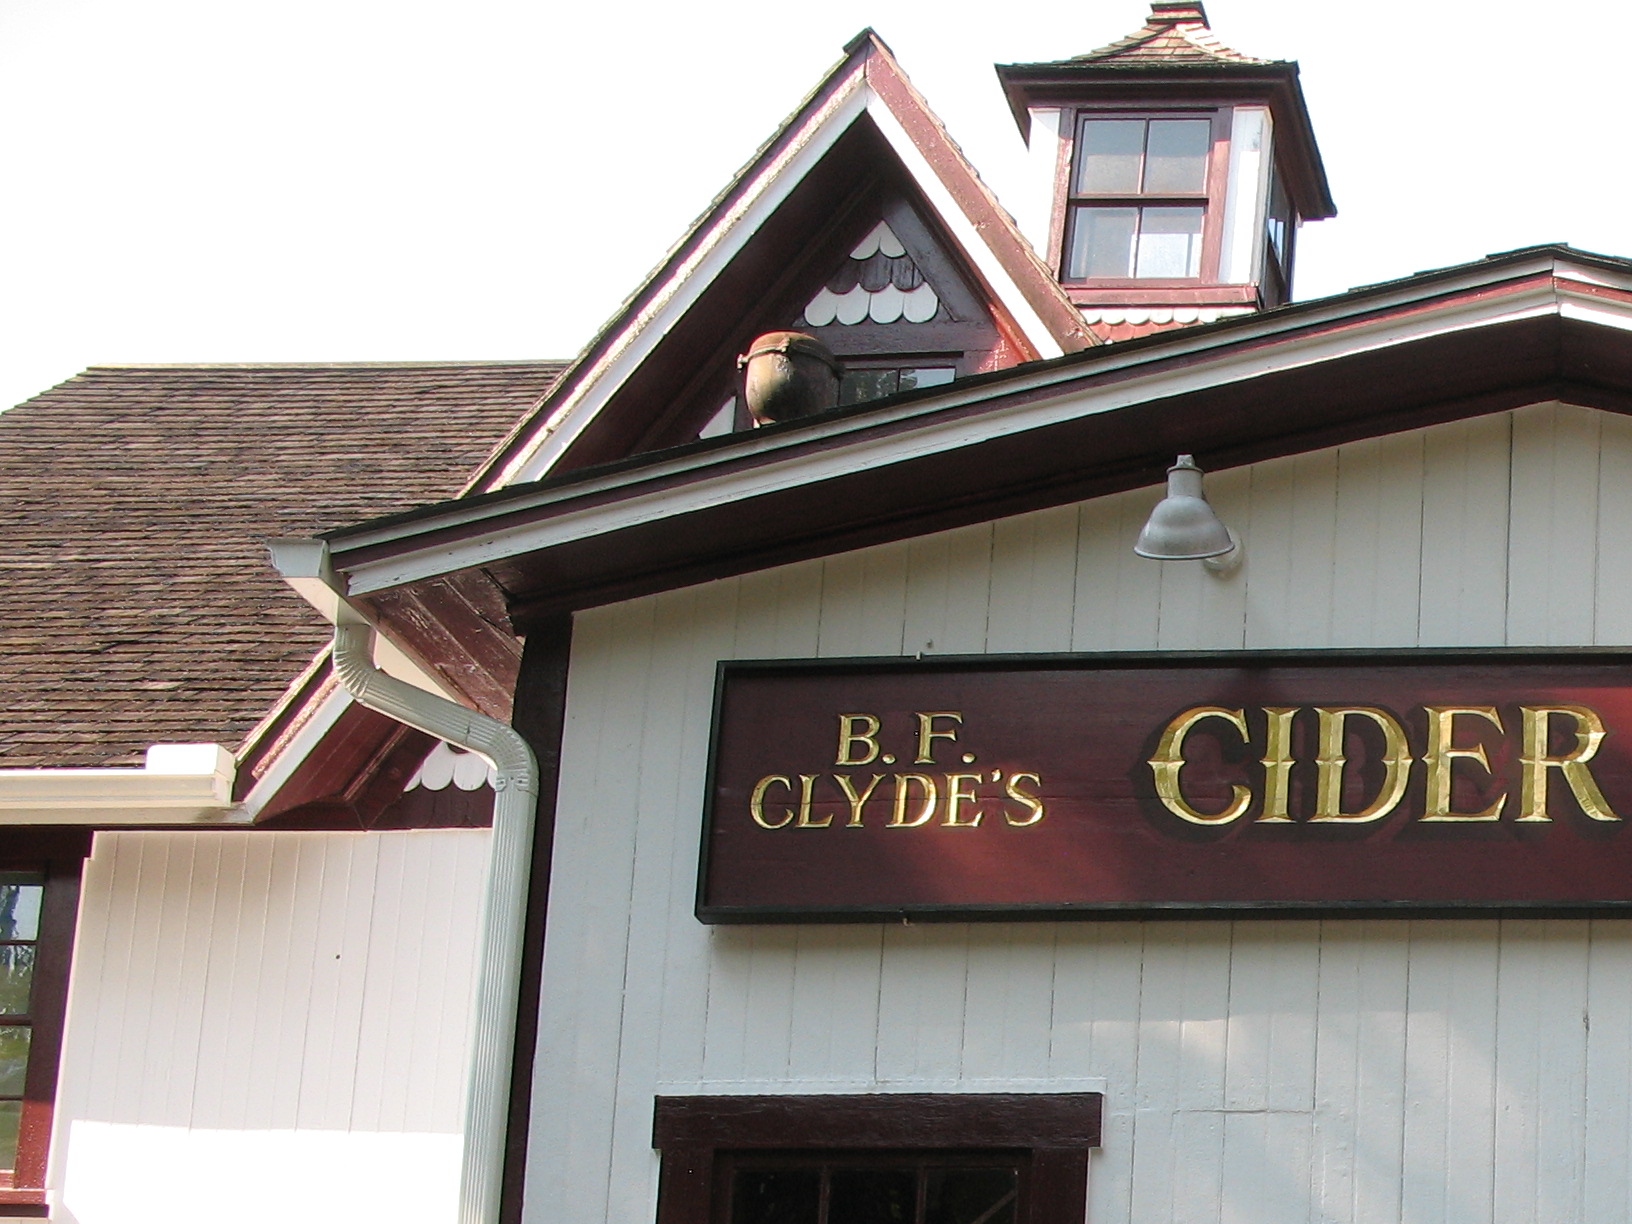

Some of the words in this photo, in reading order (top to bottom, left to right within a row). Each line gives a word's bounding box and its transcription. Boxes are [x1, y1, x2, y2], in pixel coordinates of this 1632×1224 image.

[836, 713, 897, 767] B.
[914, 710, 977, 765] F.
[1146, 704, 1622, 827] CIDER
[749, 768, 1046, 830] CLYDE'S
